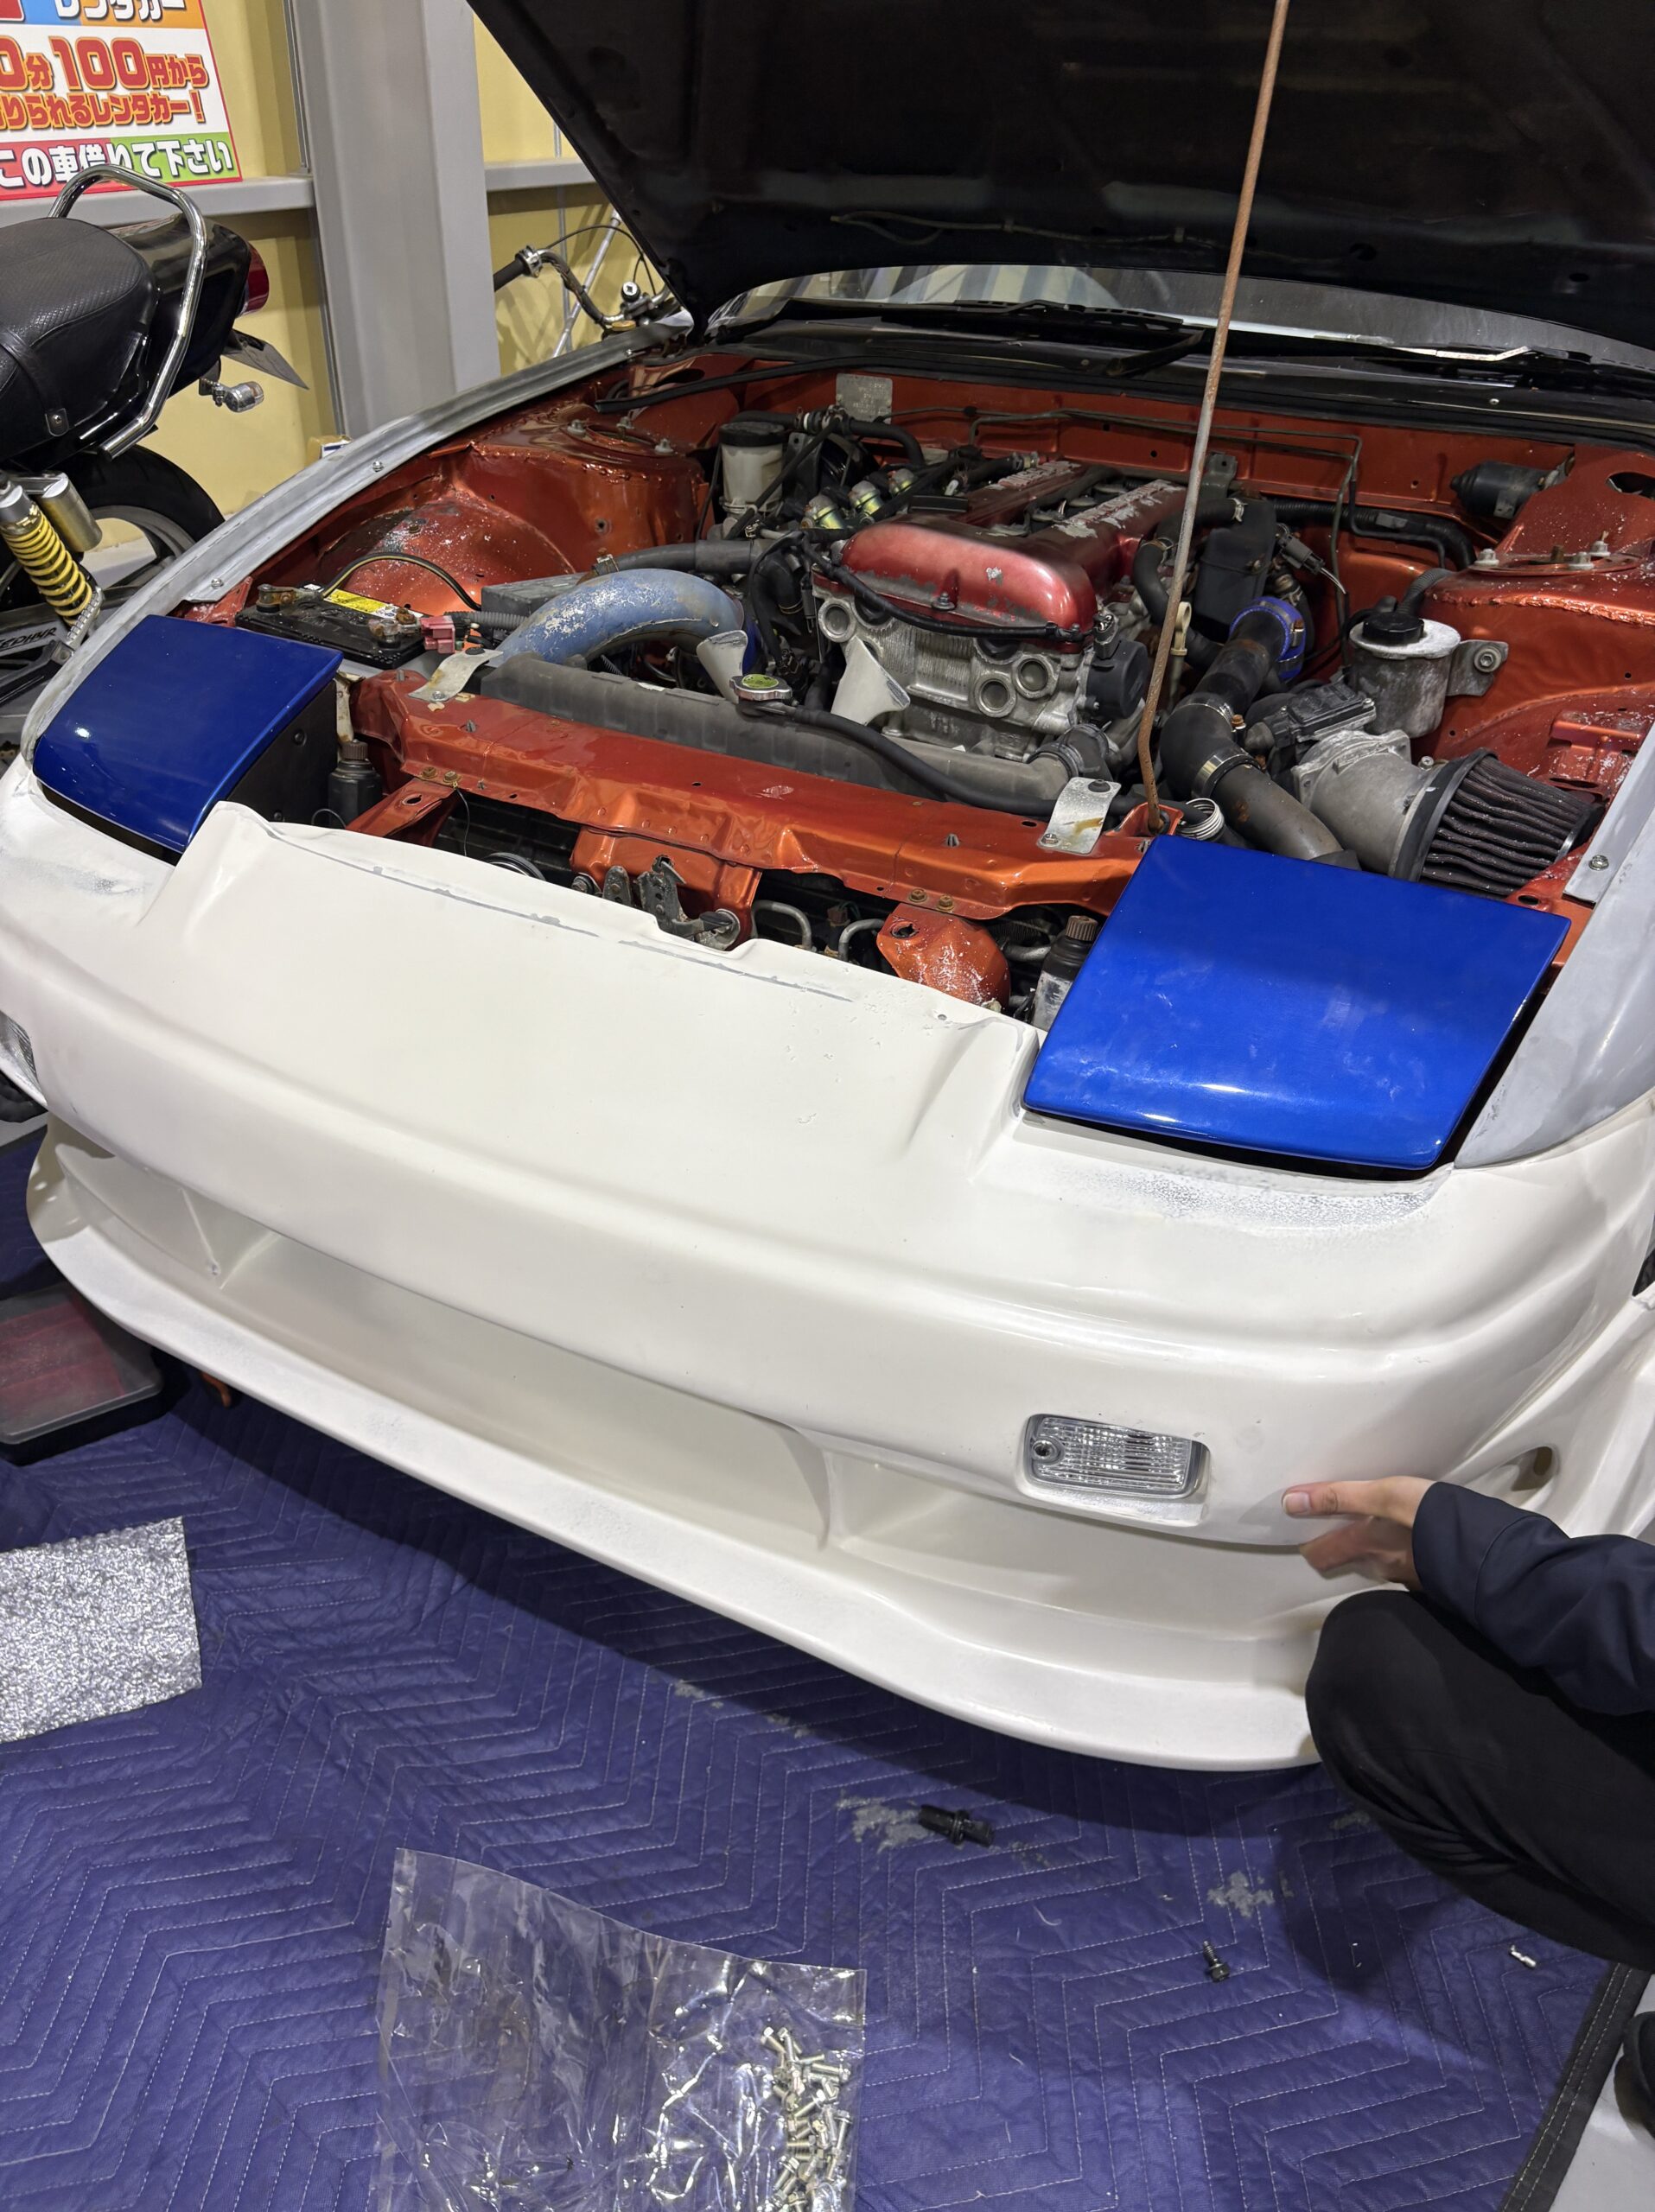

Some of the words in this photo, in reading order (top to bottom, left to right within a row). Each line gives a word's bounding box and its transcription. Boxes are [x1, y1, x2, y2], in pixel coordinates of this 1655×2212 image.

[0, 90, 206, 130] りられるレンタカー!
[0, 627, 57, 649] EPHYR
